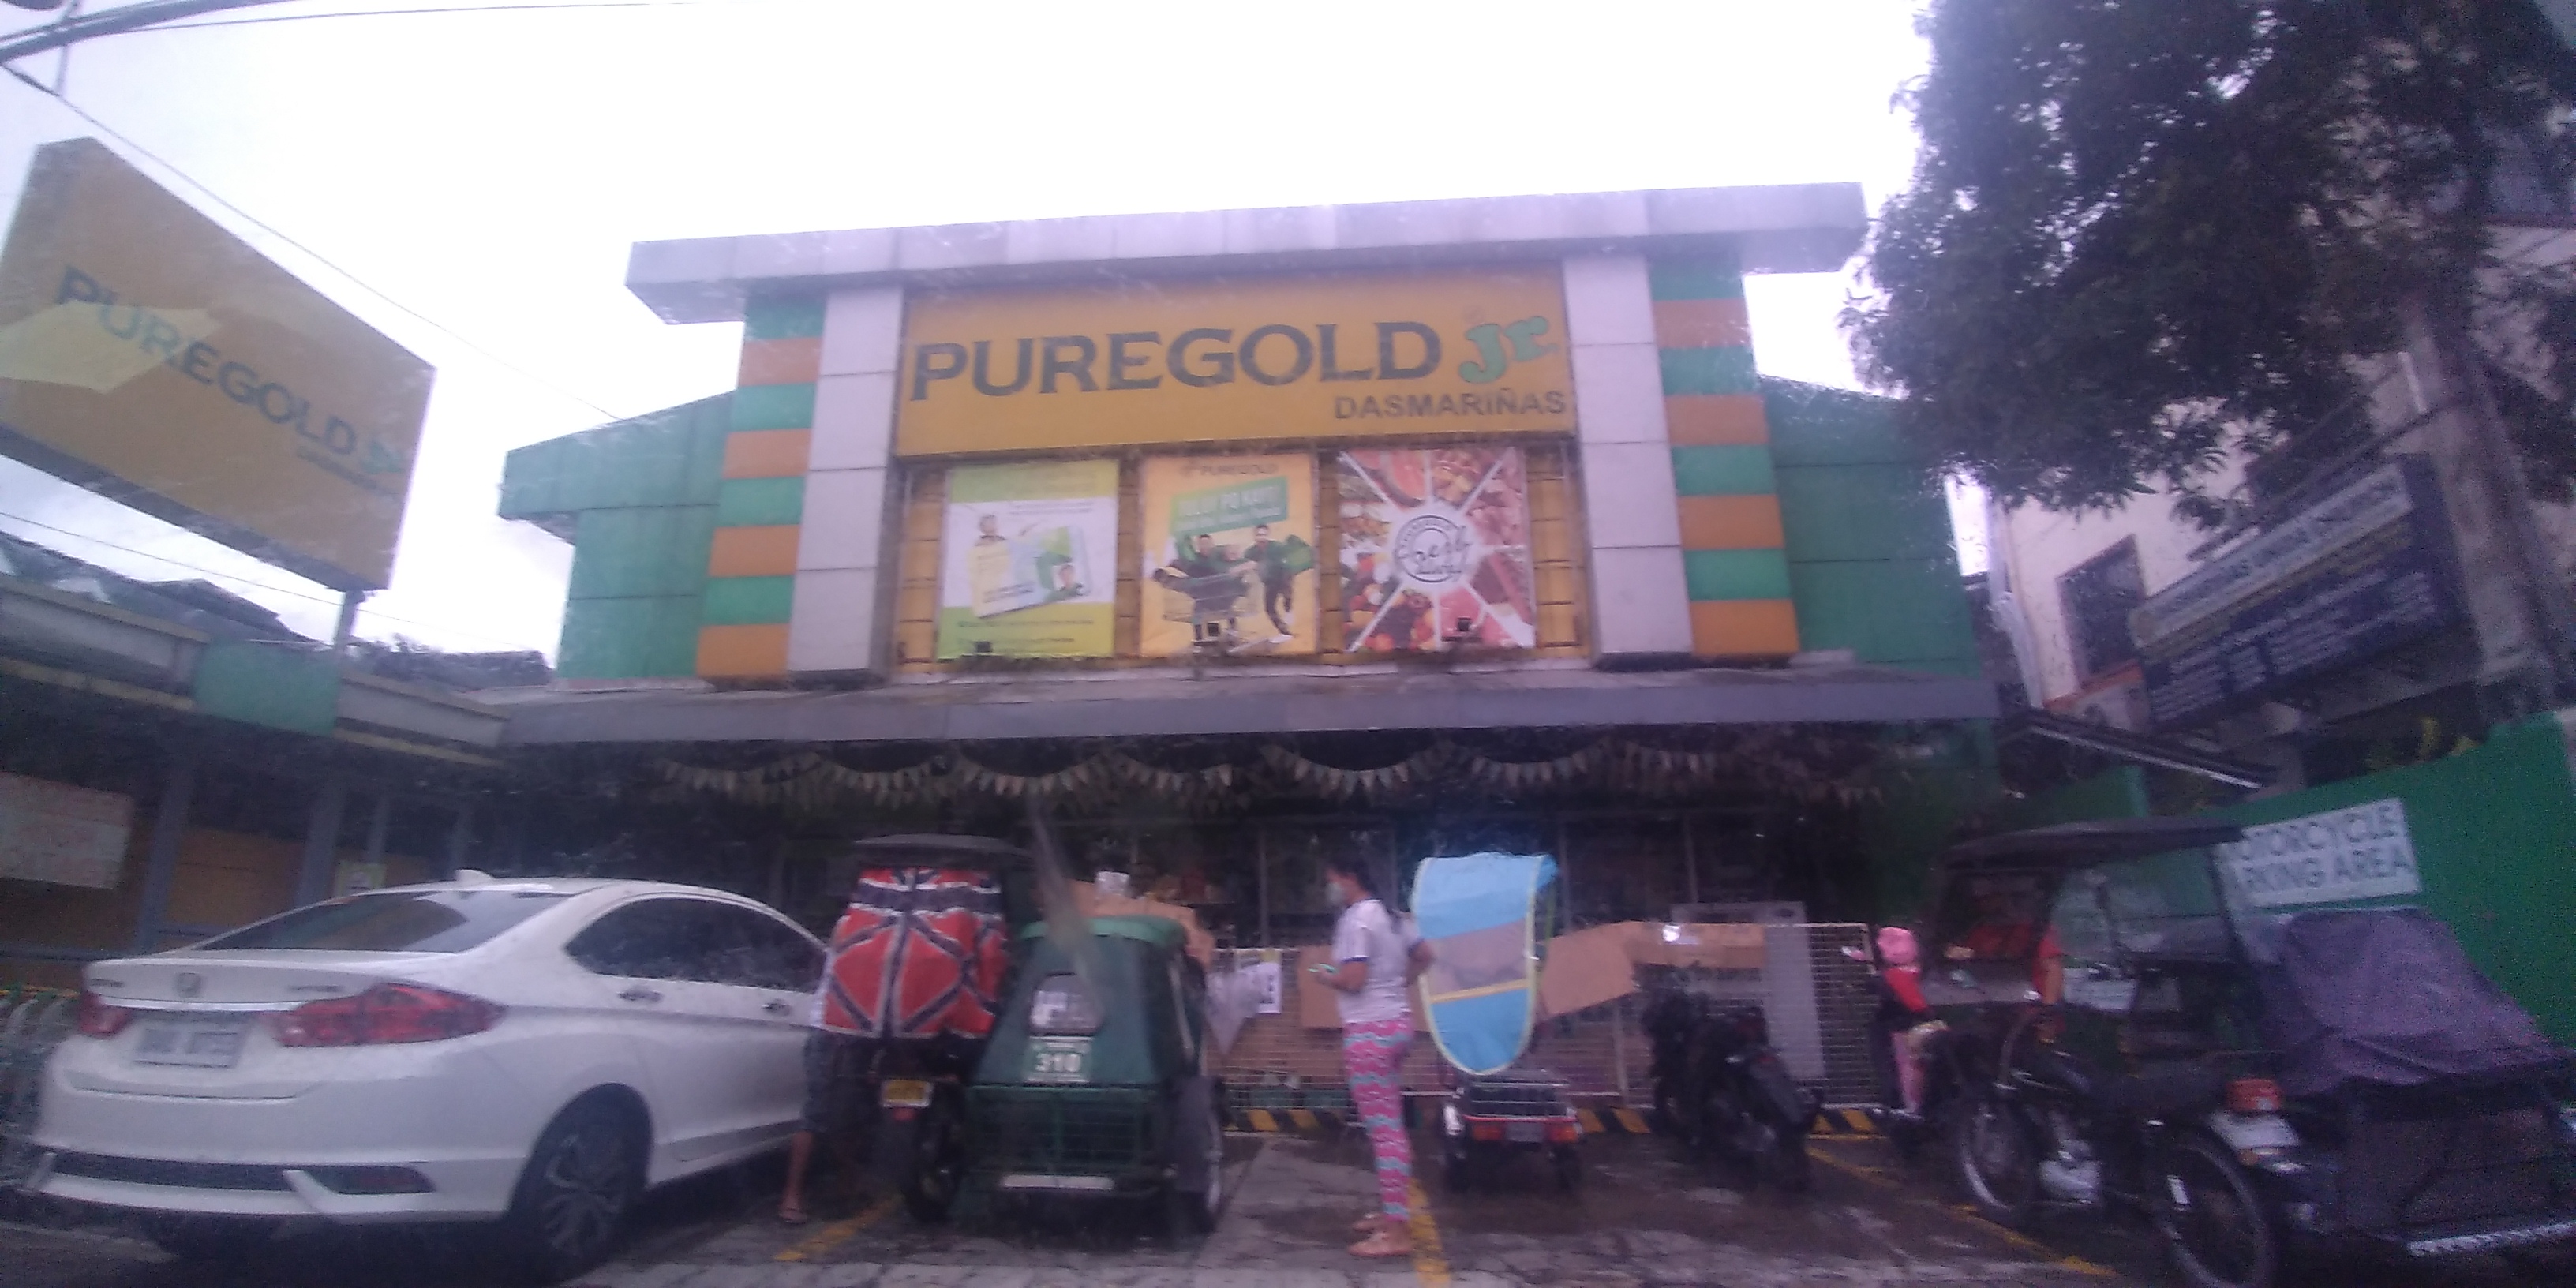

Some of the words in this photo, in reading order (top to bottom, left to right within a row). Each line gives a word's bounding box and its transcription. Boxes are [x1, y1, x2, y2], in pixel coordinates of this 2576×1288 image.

[53, 264, 356, 455] PUREGOLD
[910, 321, 1442, 401] PUREGOLD
[1334, 387, 1566, 419] DASMARIÑAS
[2232, 803, 2397, 861] OTORCYCLE
[2243, 856, 2326, 890] RKING
[2334, 845, 2410, 884] AREA
